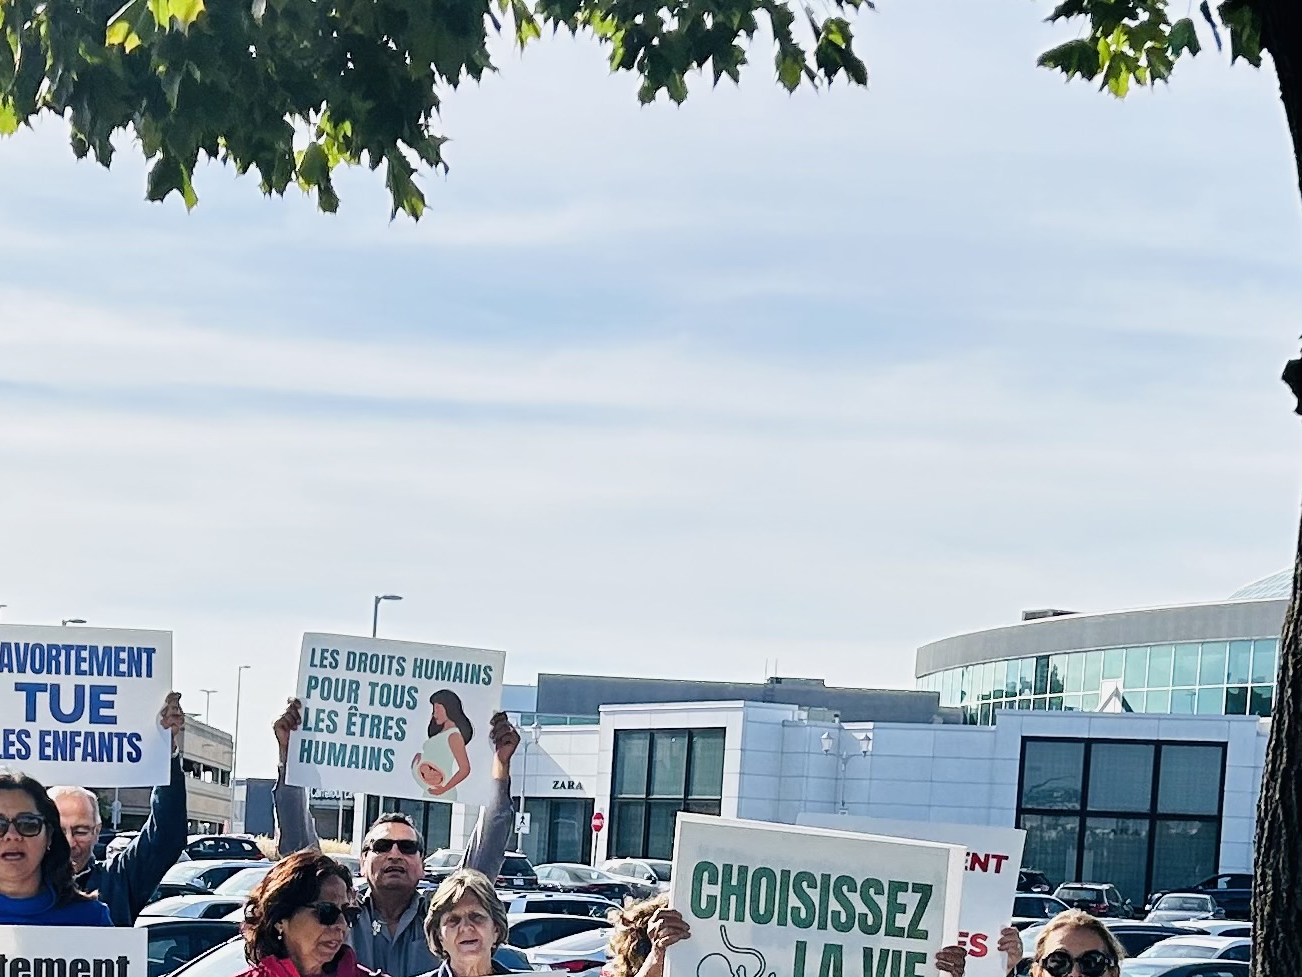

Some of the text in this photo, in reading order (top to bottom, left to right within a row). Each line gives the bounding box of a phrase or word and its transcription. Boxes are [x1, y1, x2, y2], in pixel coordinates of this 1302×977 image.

[310, 647, 493, 686] LES DROITS HUMAINS
[14, 682, 117, 725] TUE
[305, 675, 419, 710] POUR TOUS
[302, 705, 408, 742] LES ÊTRES
[39, 729, 142, 763] ENFANTS
[299, 739, 395, 773] HUMAINS
[552, 780, 584, 790] ZARA
[691, 860, 934, 941] CHOISISSEZ
